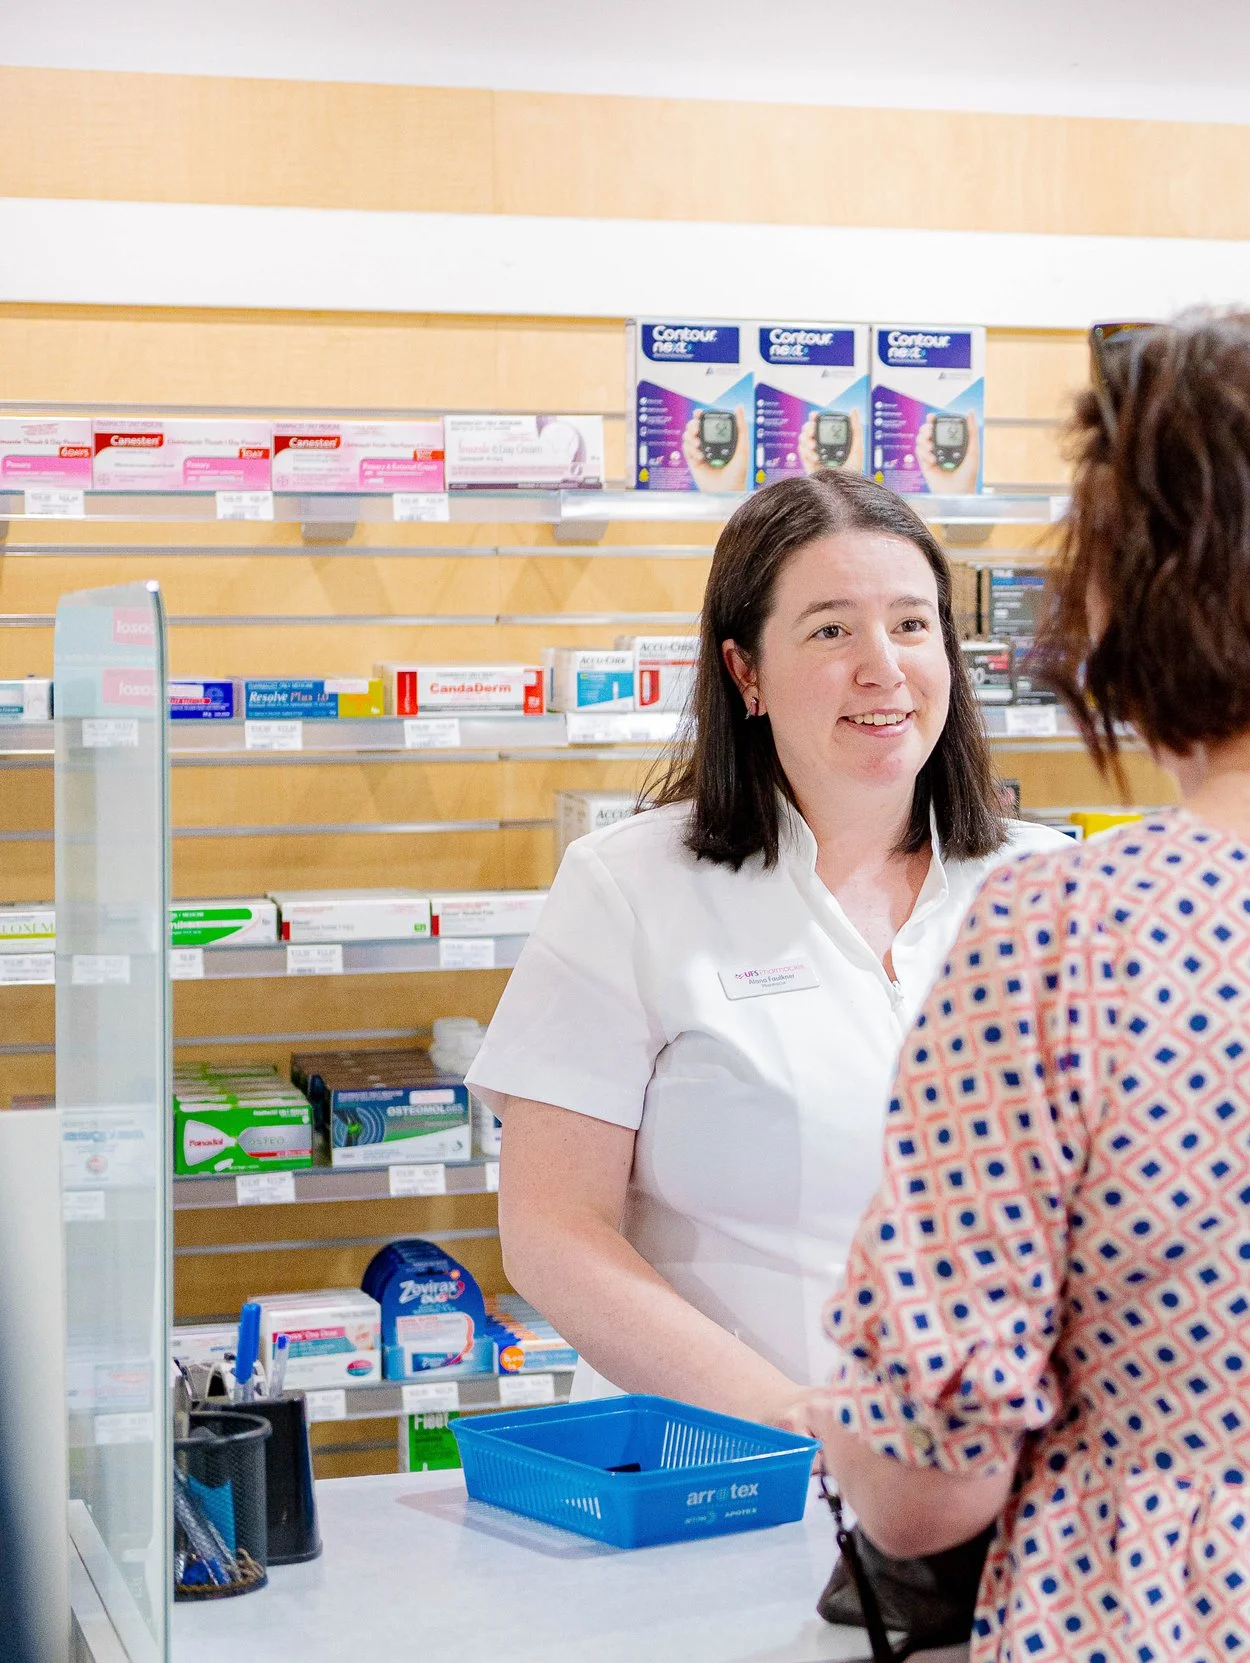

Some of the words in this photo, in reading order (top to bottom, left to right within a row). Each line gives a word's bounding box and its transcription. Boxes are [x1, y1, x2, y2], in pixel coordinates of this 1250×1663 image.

[651, 325, 718, 343] Contour
[768, 328, 833, 346] Contour
[887, 331, 951, 349] Contour
[652, 340, 687, 355] next
[769, 343, 803, 357] next
[887, 346, 922, 359] next
[110, 435, 160, 448] Canesten
[288, 436, 337, 449] Canesten
[430, 682, 511, 693] CandaDerm
[250, 690, 288, 702] Resolve
[290, 691, 313, 701] Plus
[744, 970, 759, 978] UFS
[188, 1138, 224, 1148] Panadol
[247, 1136, 285, 1146] OSTEO
[400, 1280, 458, 1304] Zovirax
